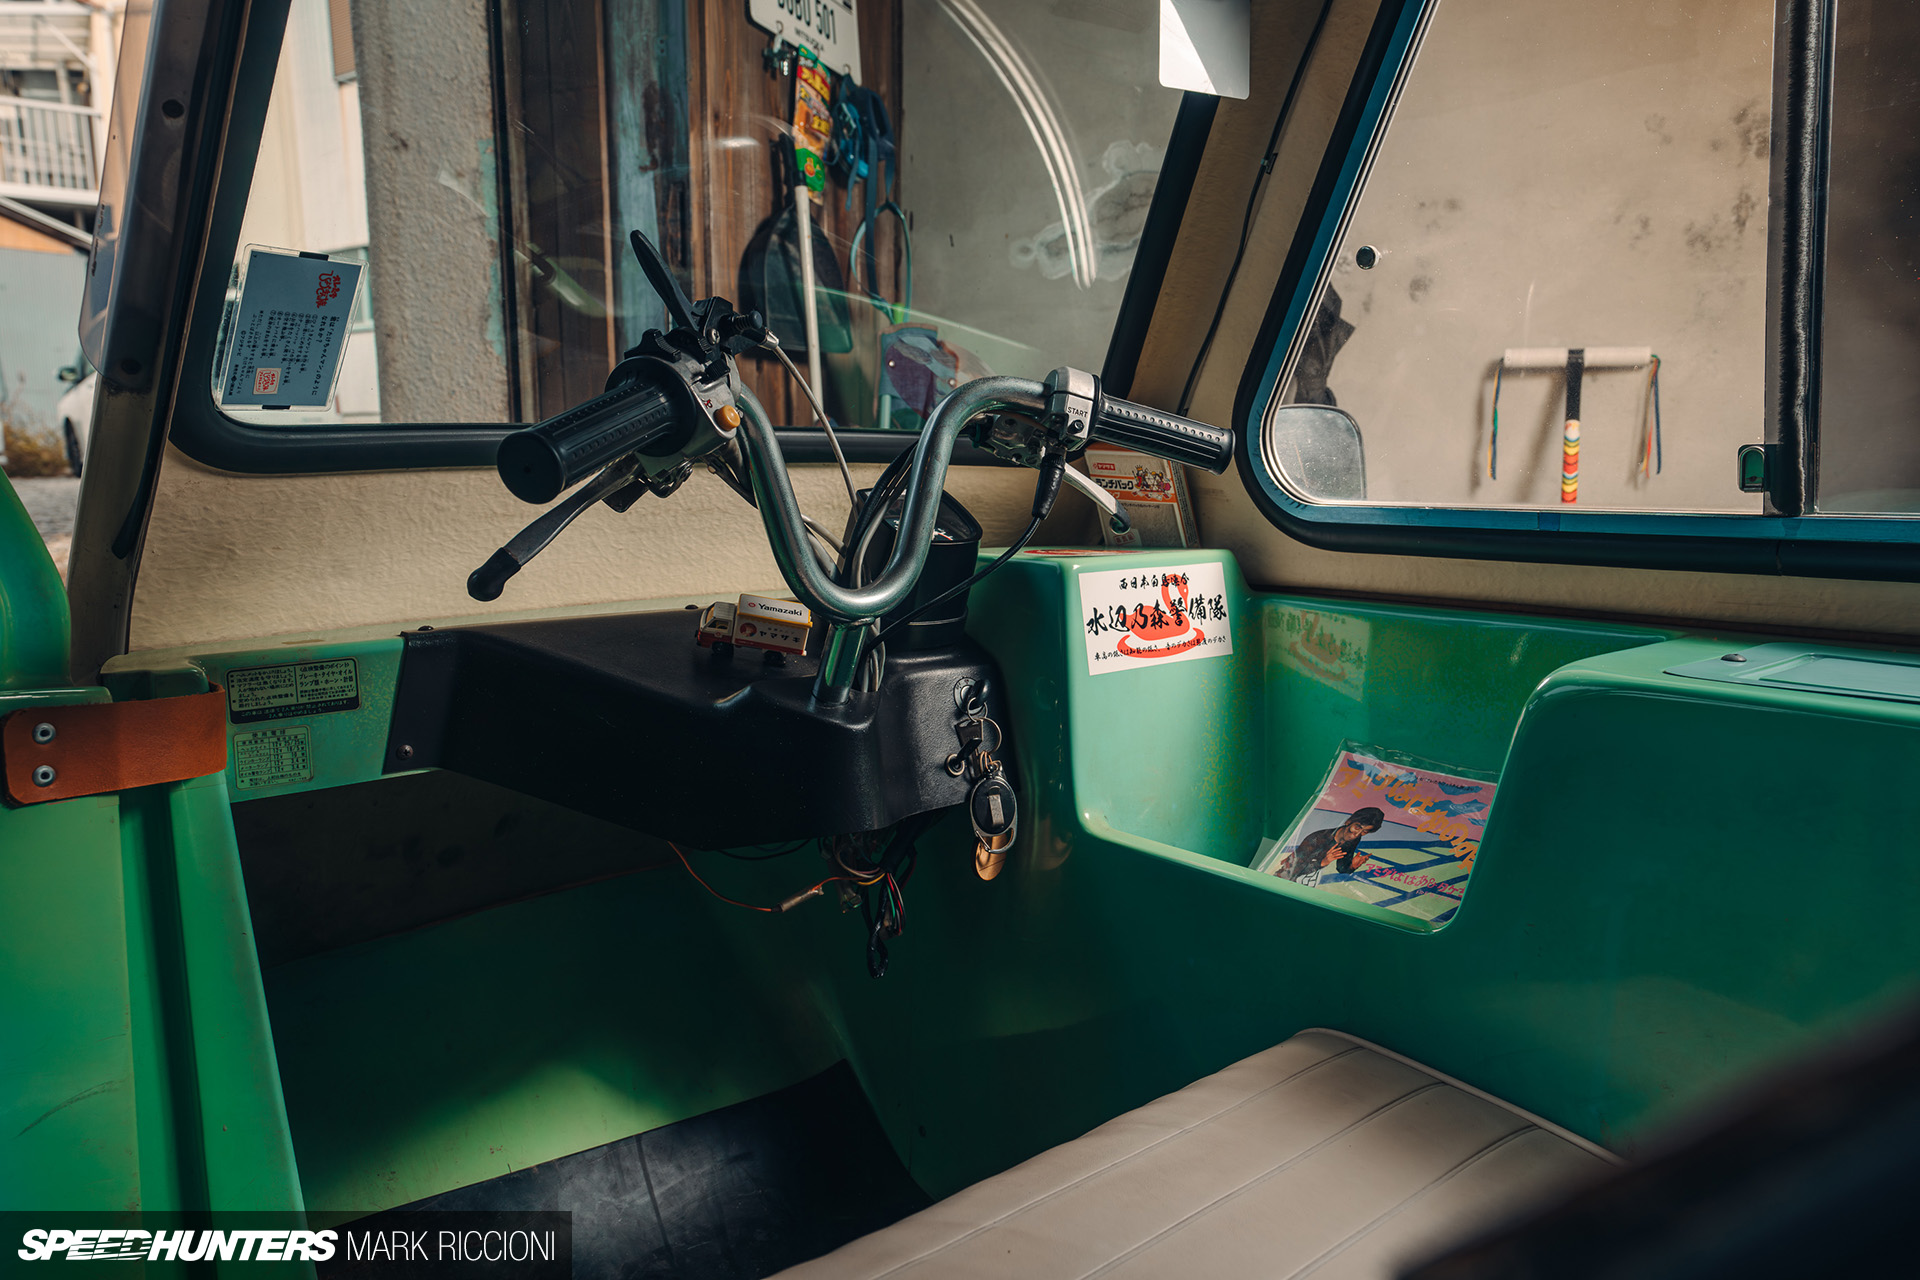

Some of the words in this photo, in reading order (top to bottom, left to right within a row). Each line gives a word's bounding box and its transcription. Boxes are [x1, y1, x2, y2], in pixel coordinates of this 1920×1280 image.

[1067, 406, 1088, 418] START
[758, 603, 803, 616] Yamazaki
[759, 630, 801, 643] ヤマザキ
